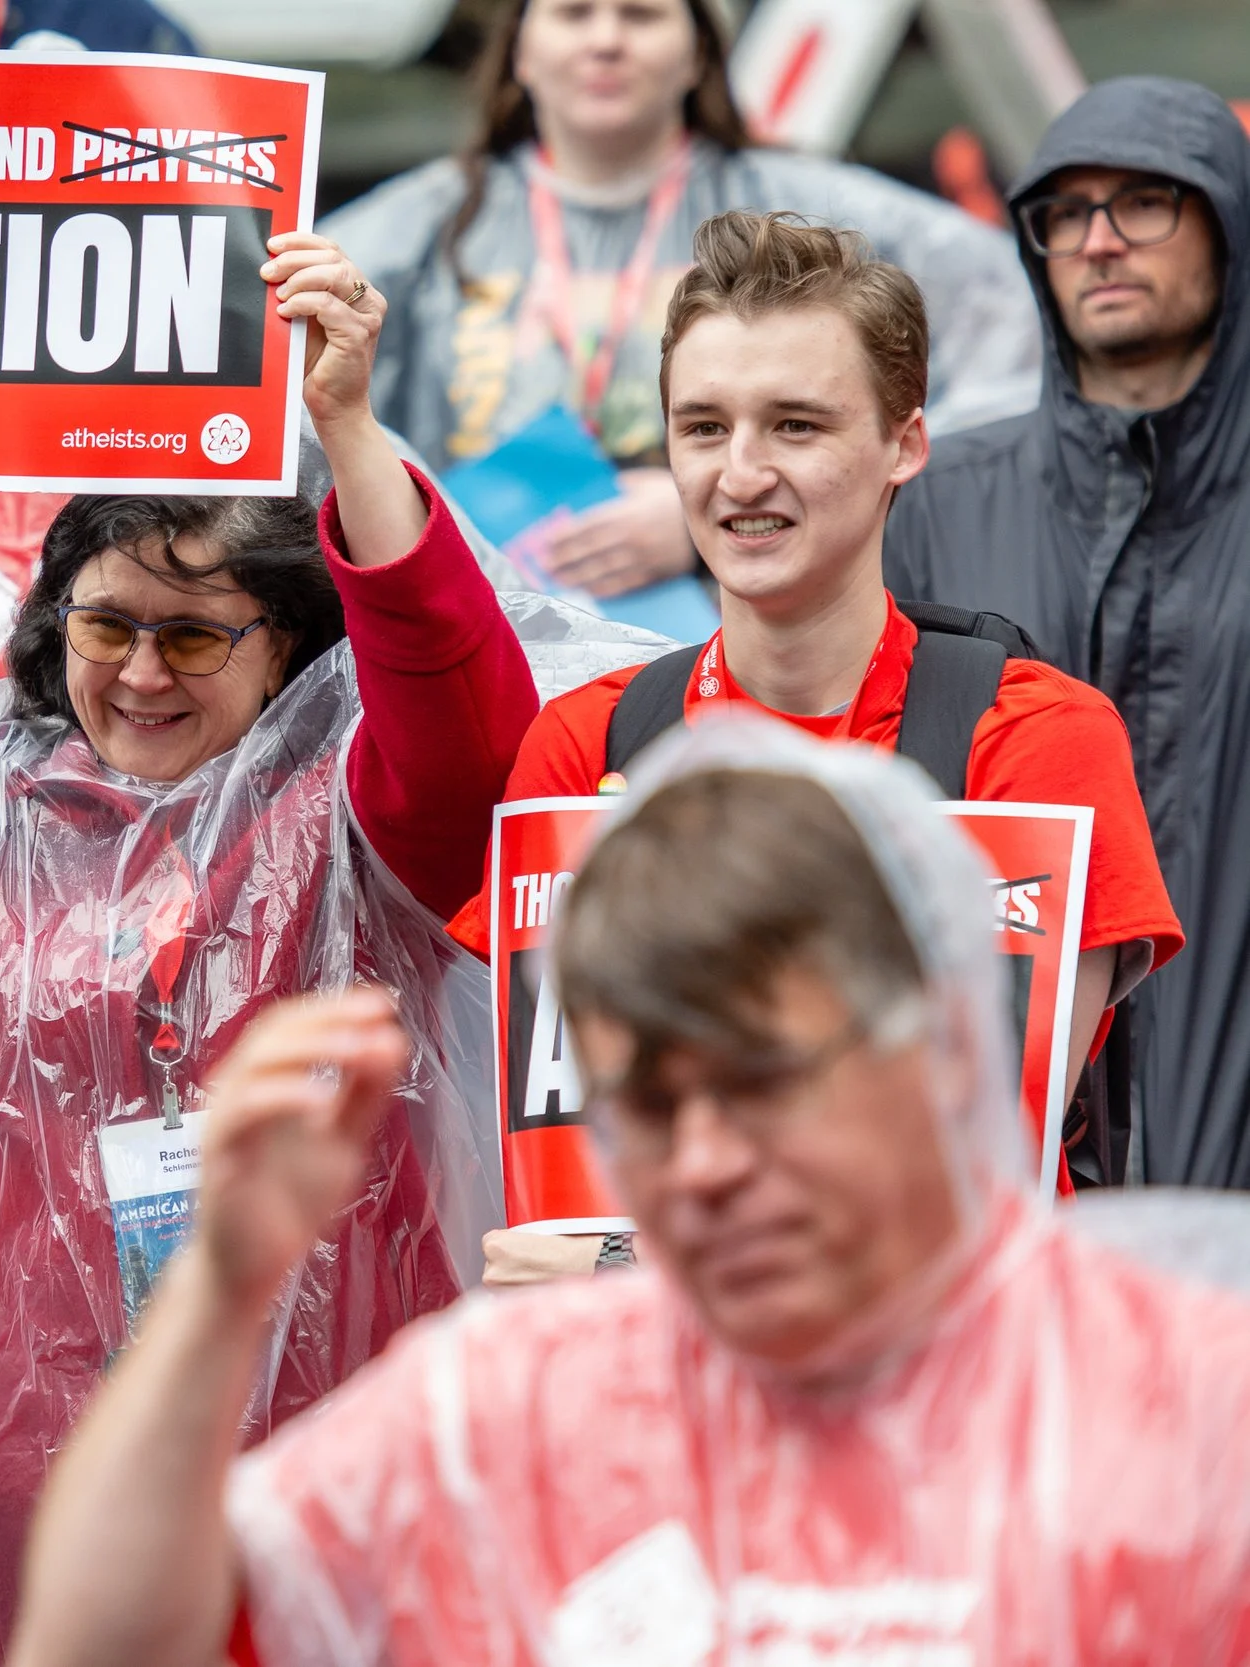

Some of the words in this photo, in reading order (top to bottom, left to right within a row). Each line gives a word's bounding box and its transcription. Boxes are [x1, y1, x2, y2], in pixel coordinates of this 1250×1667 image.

[72, 128, 277, 189] PRAYERS
[61, 427, 187, 454] atheists.org
[120, 1200, 189, 1221] AMERICAN
